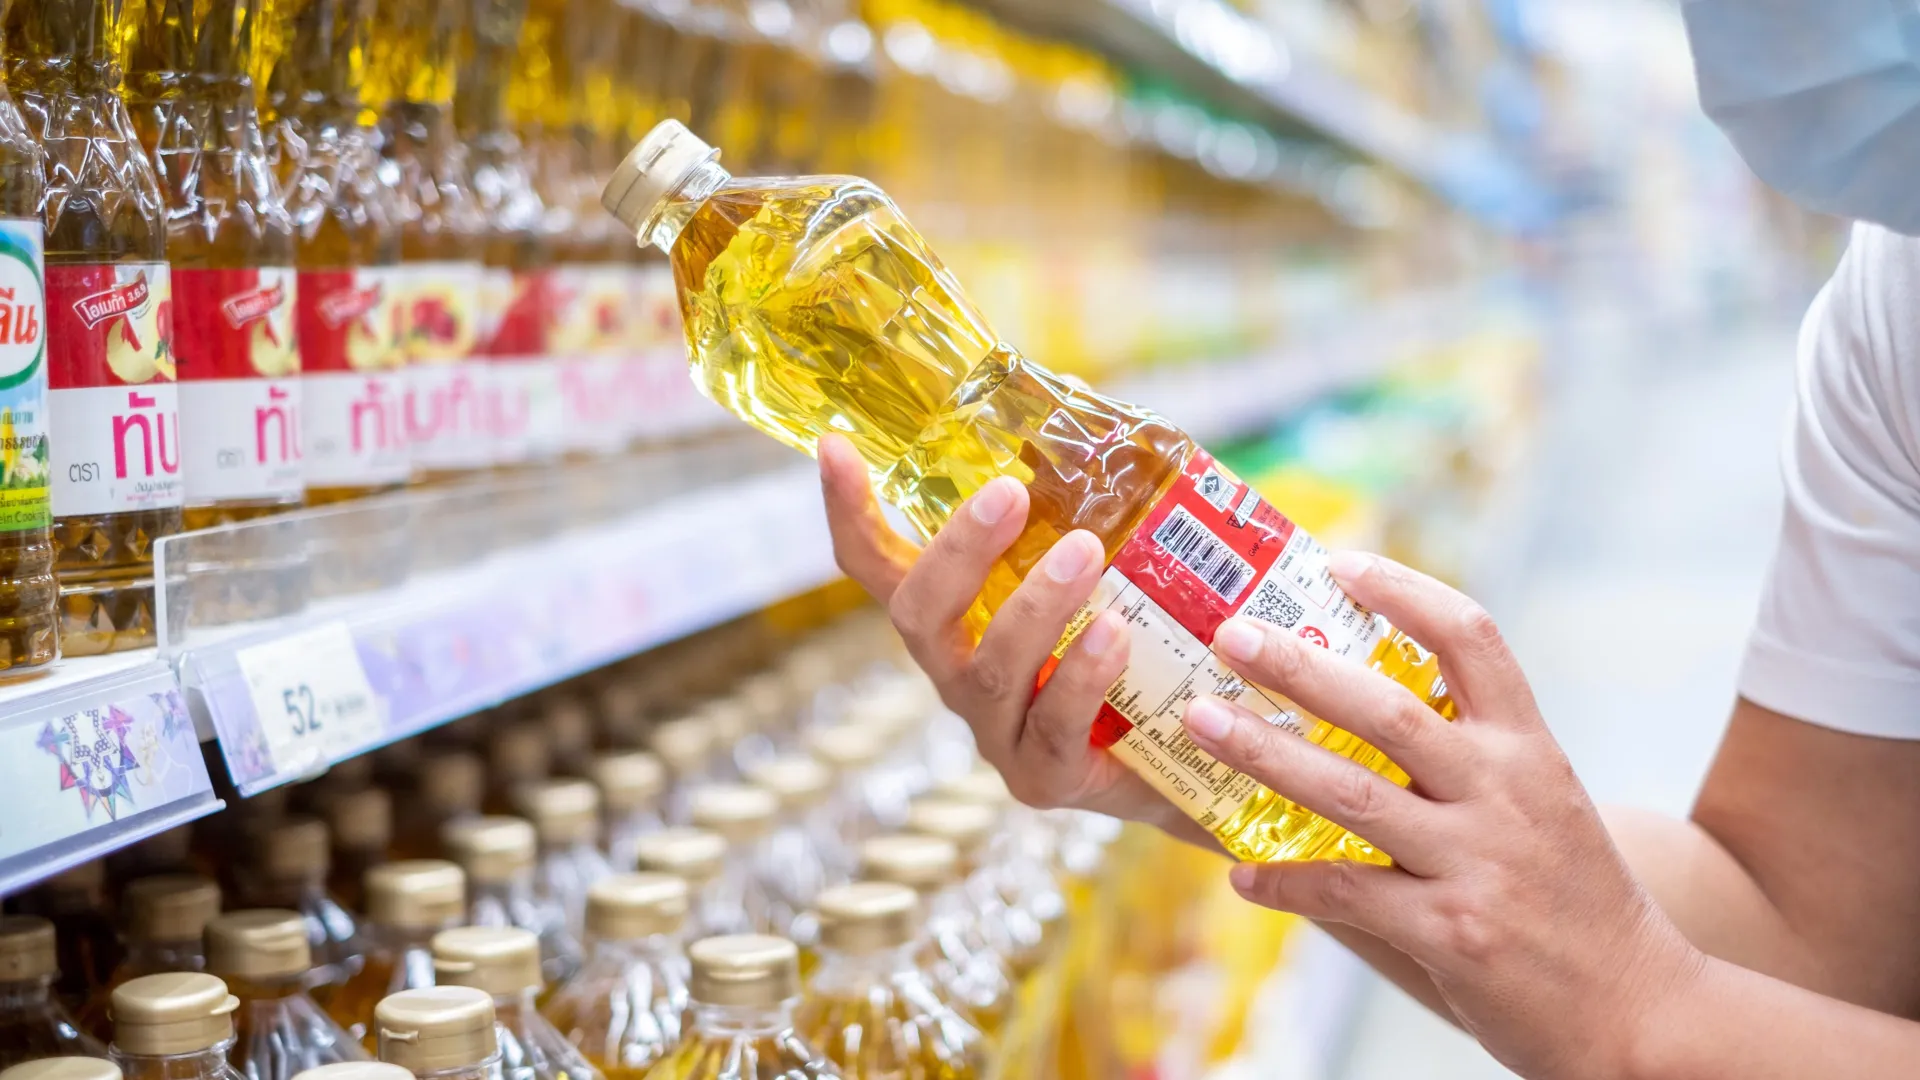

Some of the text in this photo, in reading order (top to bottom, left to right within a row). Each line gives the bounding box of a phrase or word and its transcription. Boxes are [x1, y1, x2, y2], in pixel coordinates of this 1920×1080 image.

[69, 462, 100, 482] ตรา
[283, 684, 321, 735] 52
[1113, 725, 1198, 800] ปริมาตรสุทธิ
